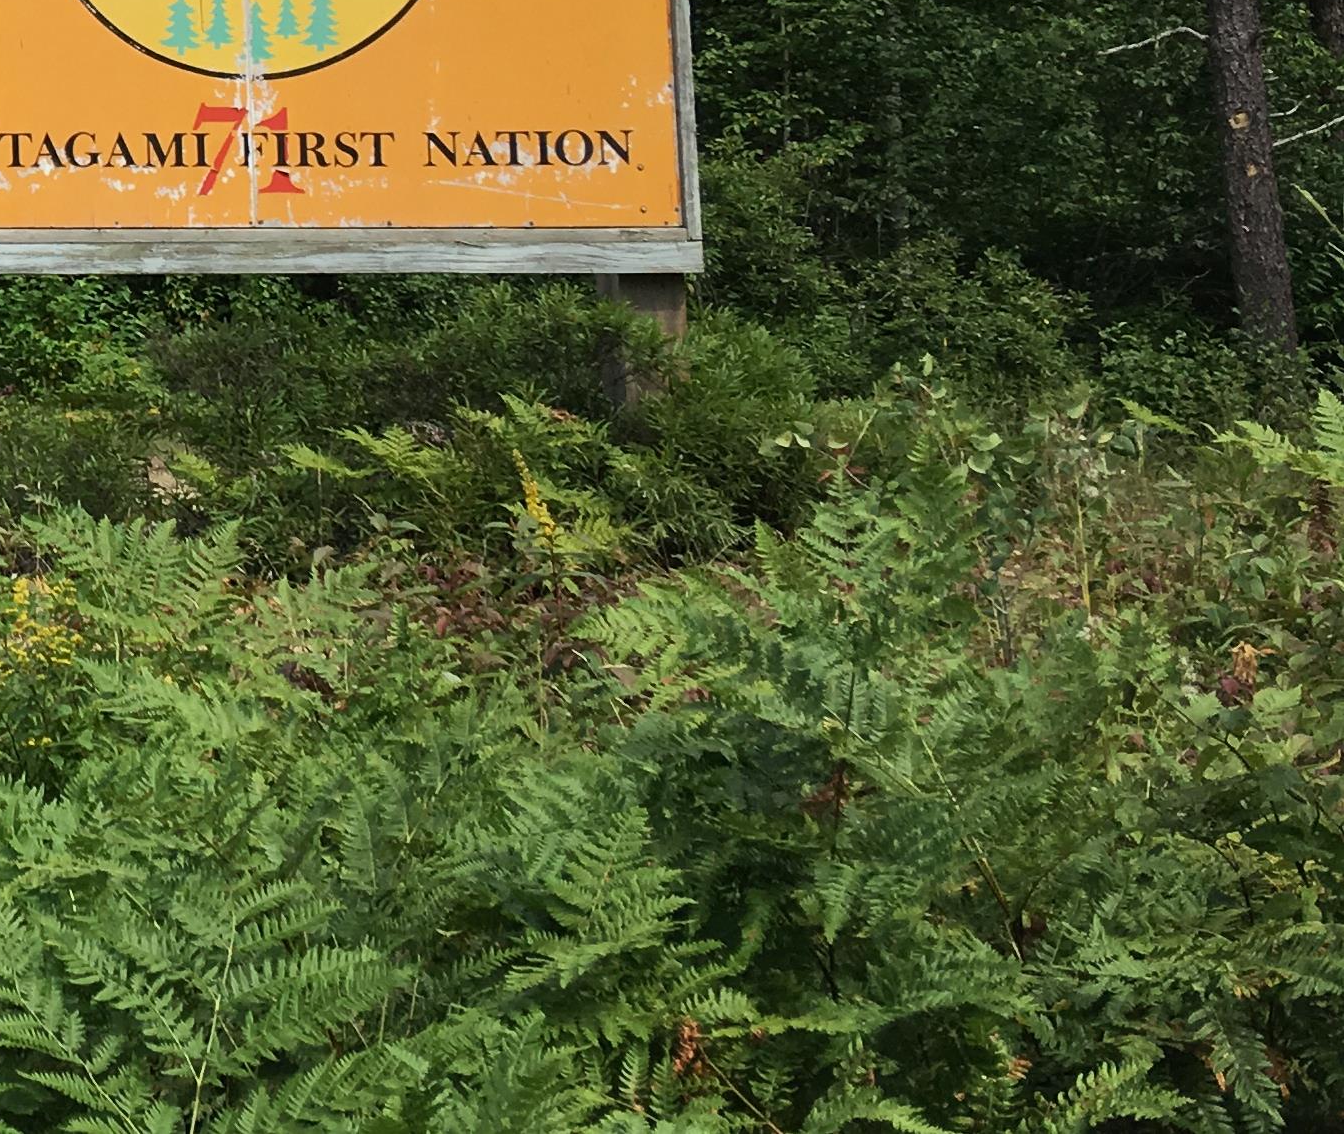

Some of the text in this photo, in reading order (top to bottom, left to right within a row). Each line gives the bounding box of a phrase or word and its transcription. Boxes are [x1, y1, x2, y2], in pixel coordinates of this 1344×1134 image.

[192, 102, 306, 196] 71
[239, 131, 395, 168] FIRST
[422, 129, 634, 168] NATION
